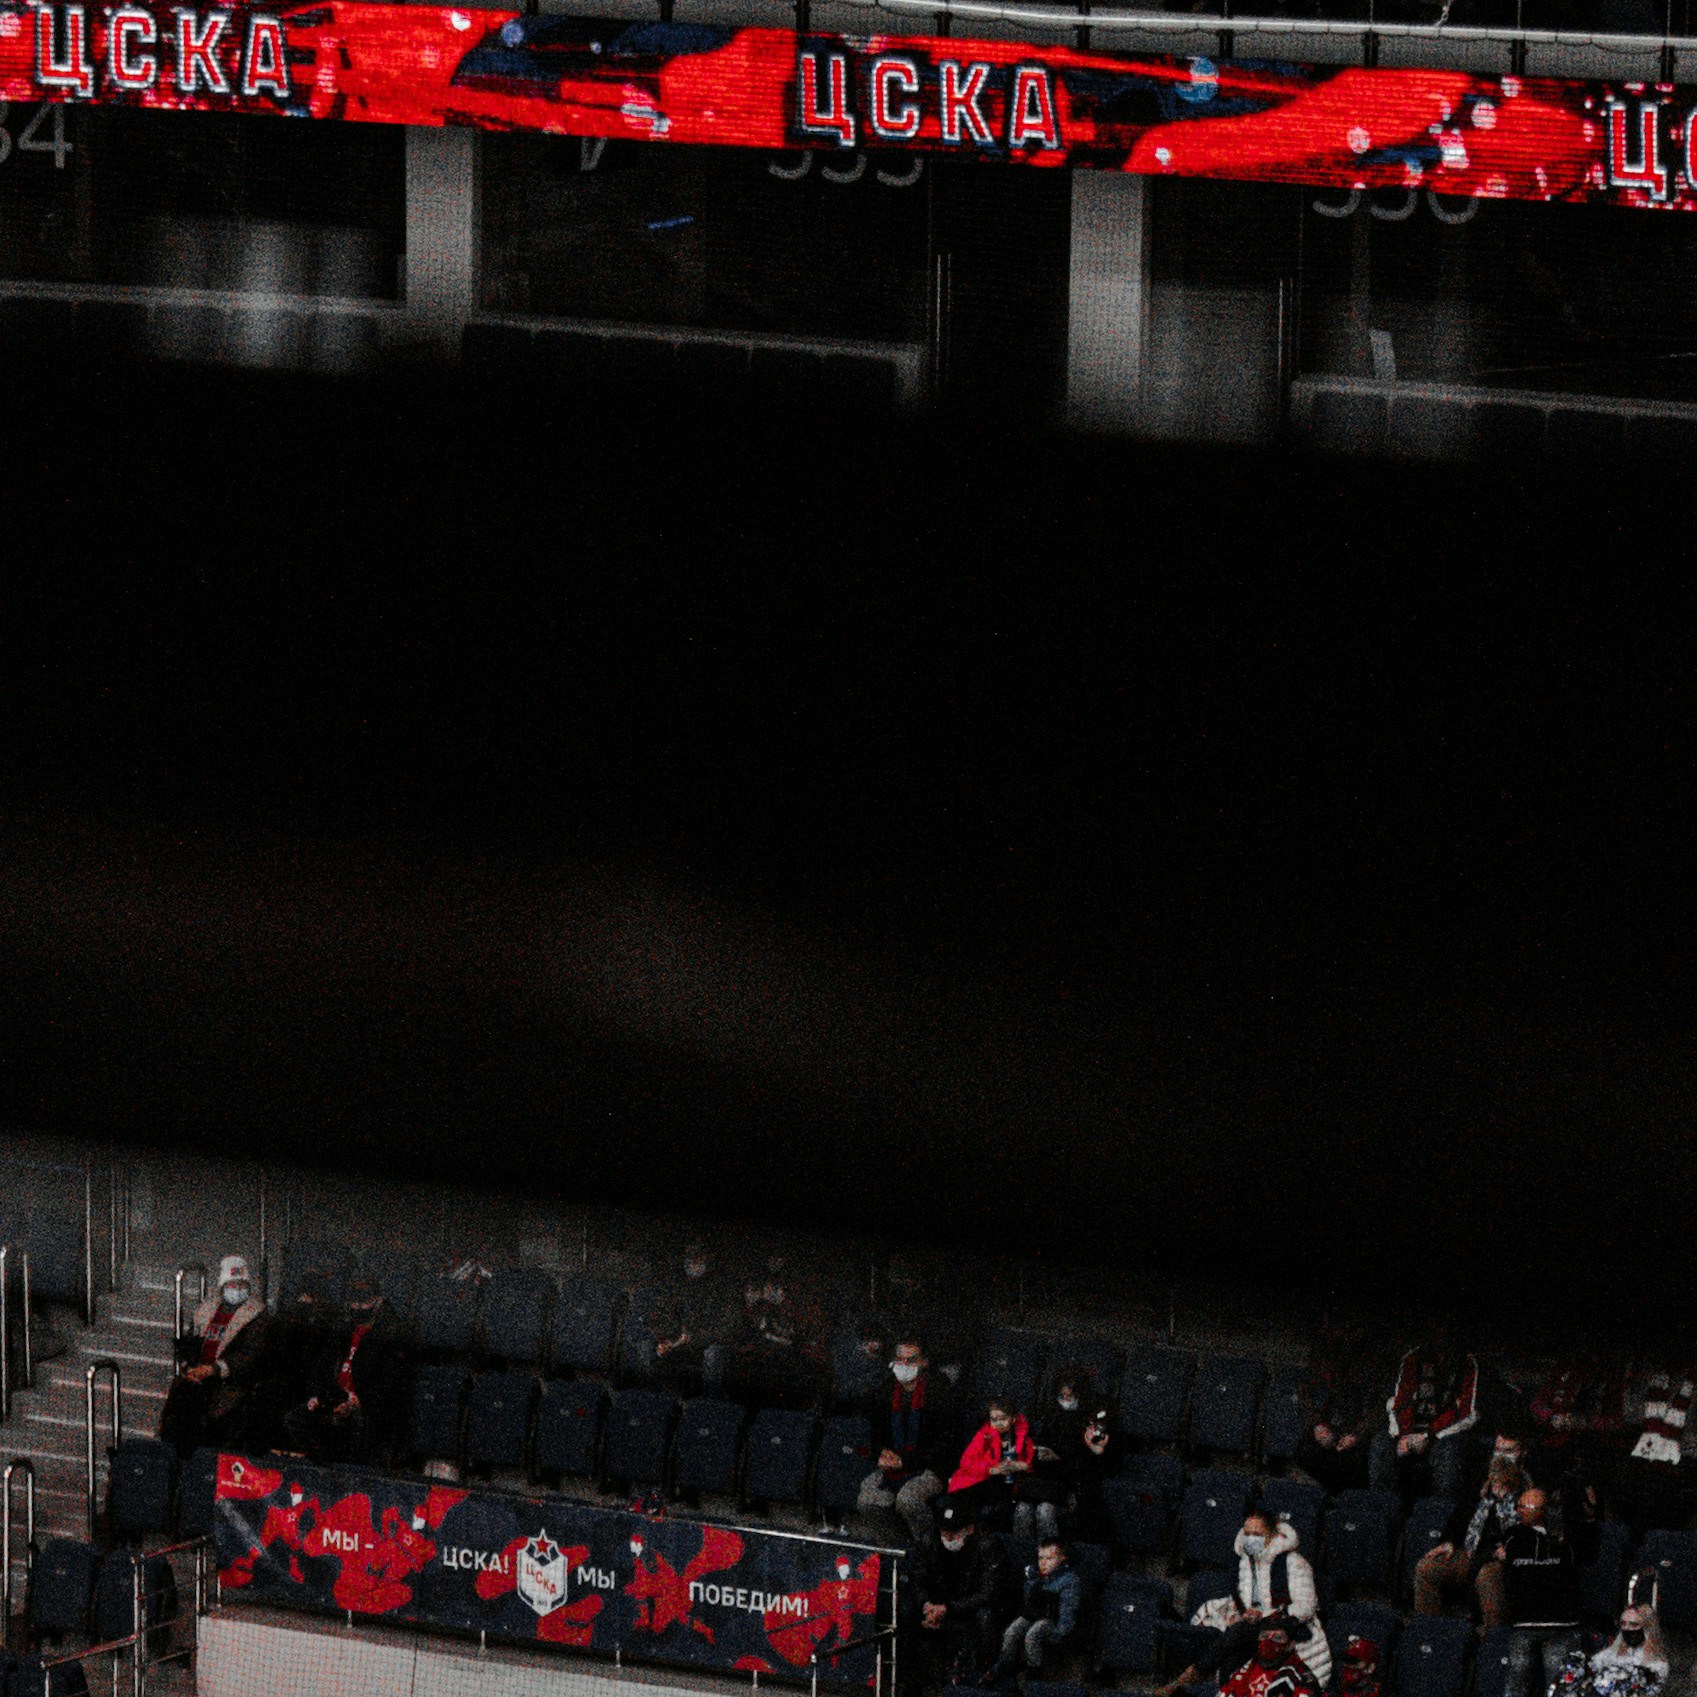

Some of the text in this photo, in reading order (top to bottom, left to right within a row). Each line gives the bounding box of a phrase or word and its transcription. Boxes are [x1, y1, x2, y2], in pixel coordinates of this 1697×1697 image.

[34, 4, 291, 98] ЦСКА
[798, 51, 1063, 150] ЦСКА
[1609, 101, 1697, 201] Ц
[321, 1527, 360, 1553] МЫ
[442, 1545, 510, 1576] ЦСКА!
[577, 1565, 616, 1590] МЫ
[688, 1580, 810, 1618] ПОБЕДИМ!
